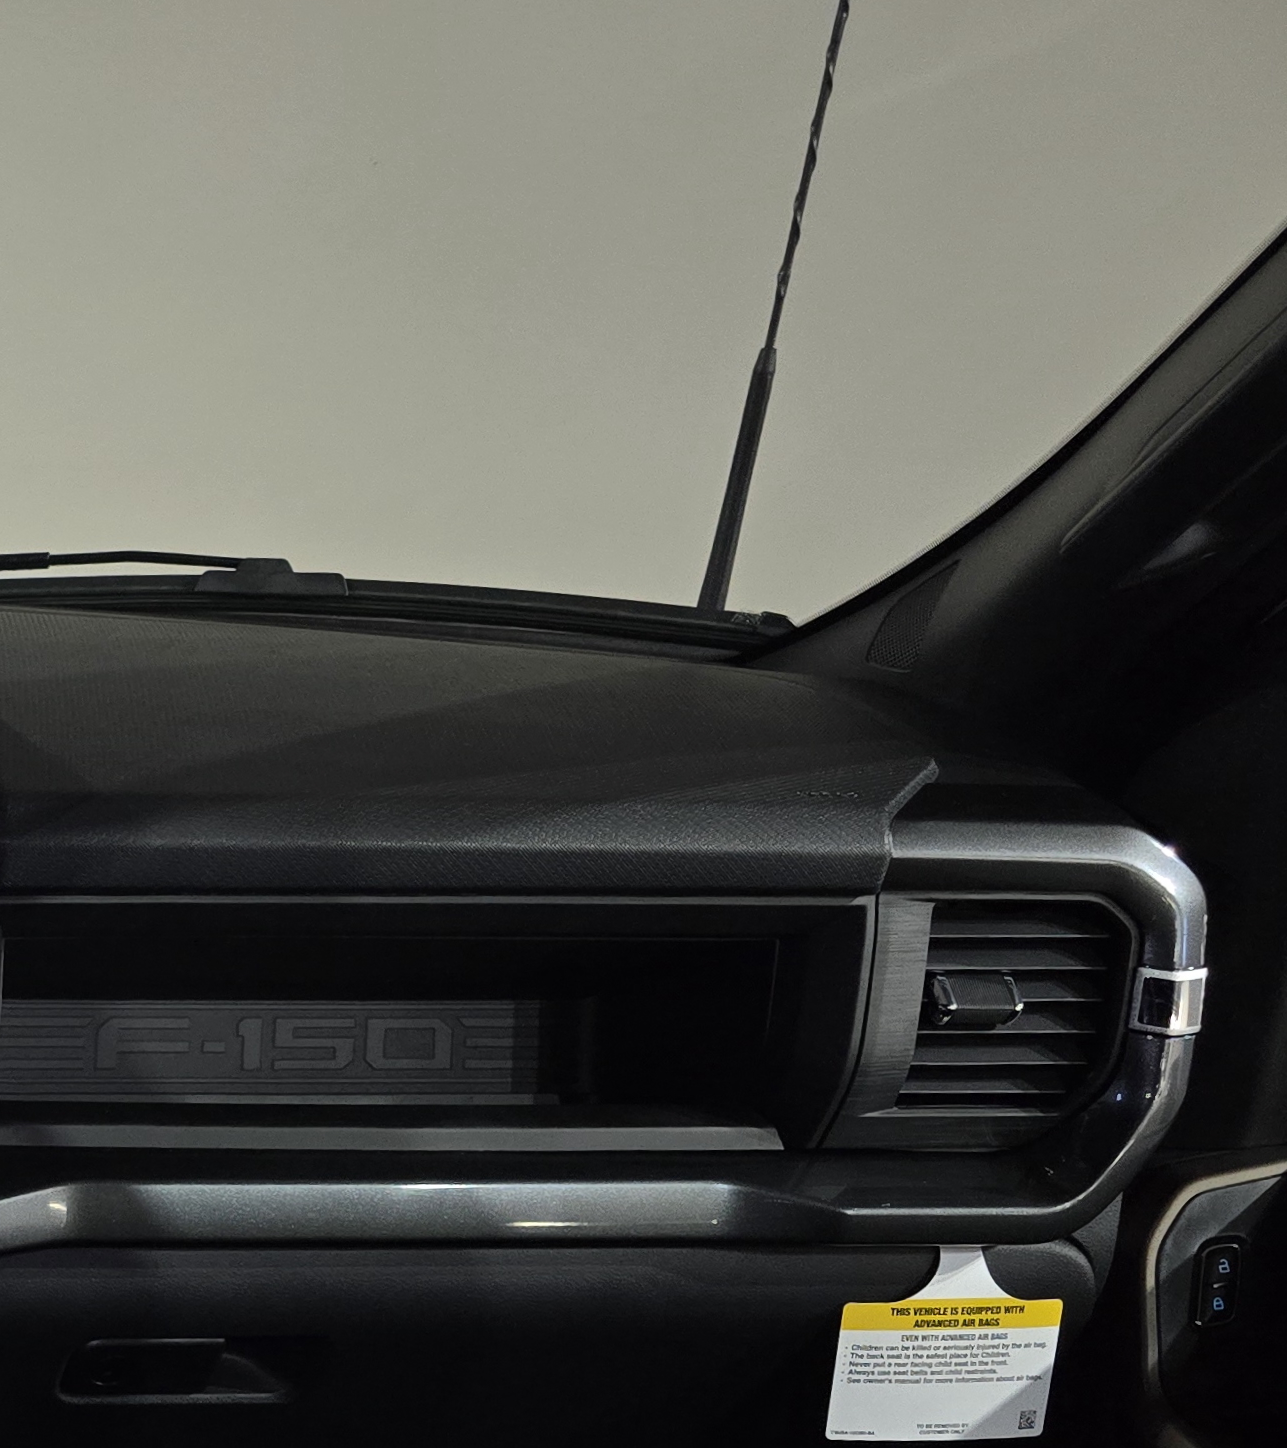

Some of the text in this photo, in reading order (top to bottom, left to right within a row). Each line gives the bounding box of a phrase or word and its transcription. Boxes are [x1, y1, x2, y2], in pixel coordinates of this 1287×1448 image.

[94, 1016, 454, 1073] F-150
[890, 1305, 1025, 1316] THIS VEHICLE IS EQUIPPED WITH
[913, 1318, 1000, 1328] ADVANCED AIR BAGS
[901, 1334, 919, 1342] EVEN
[921, 1334, 940, 1342] WITH
[977, 1333, 990, 1341] AIR
